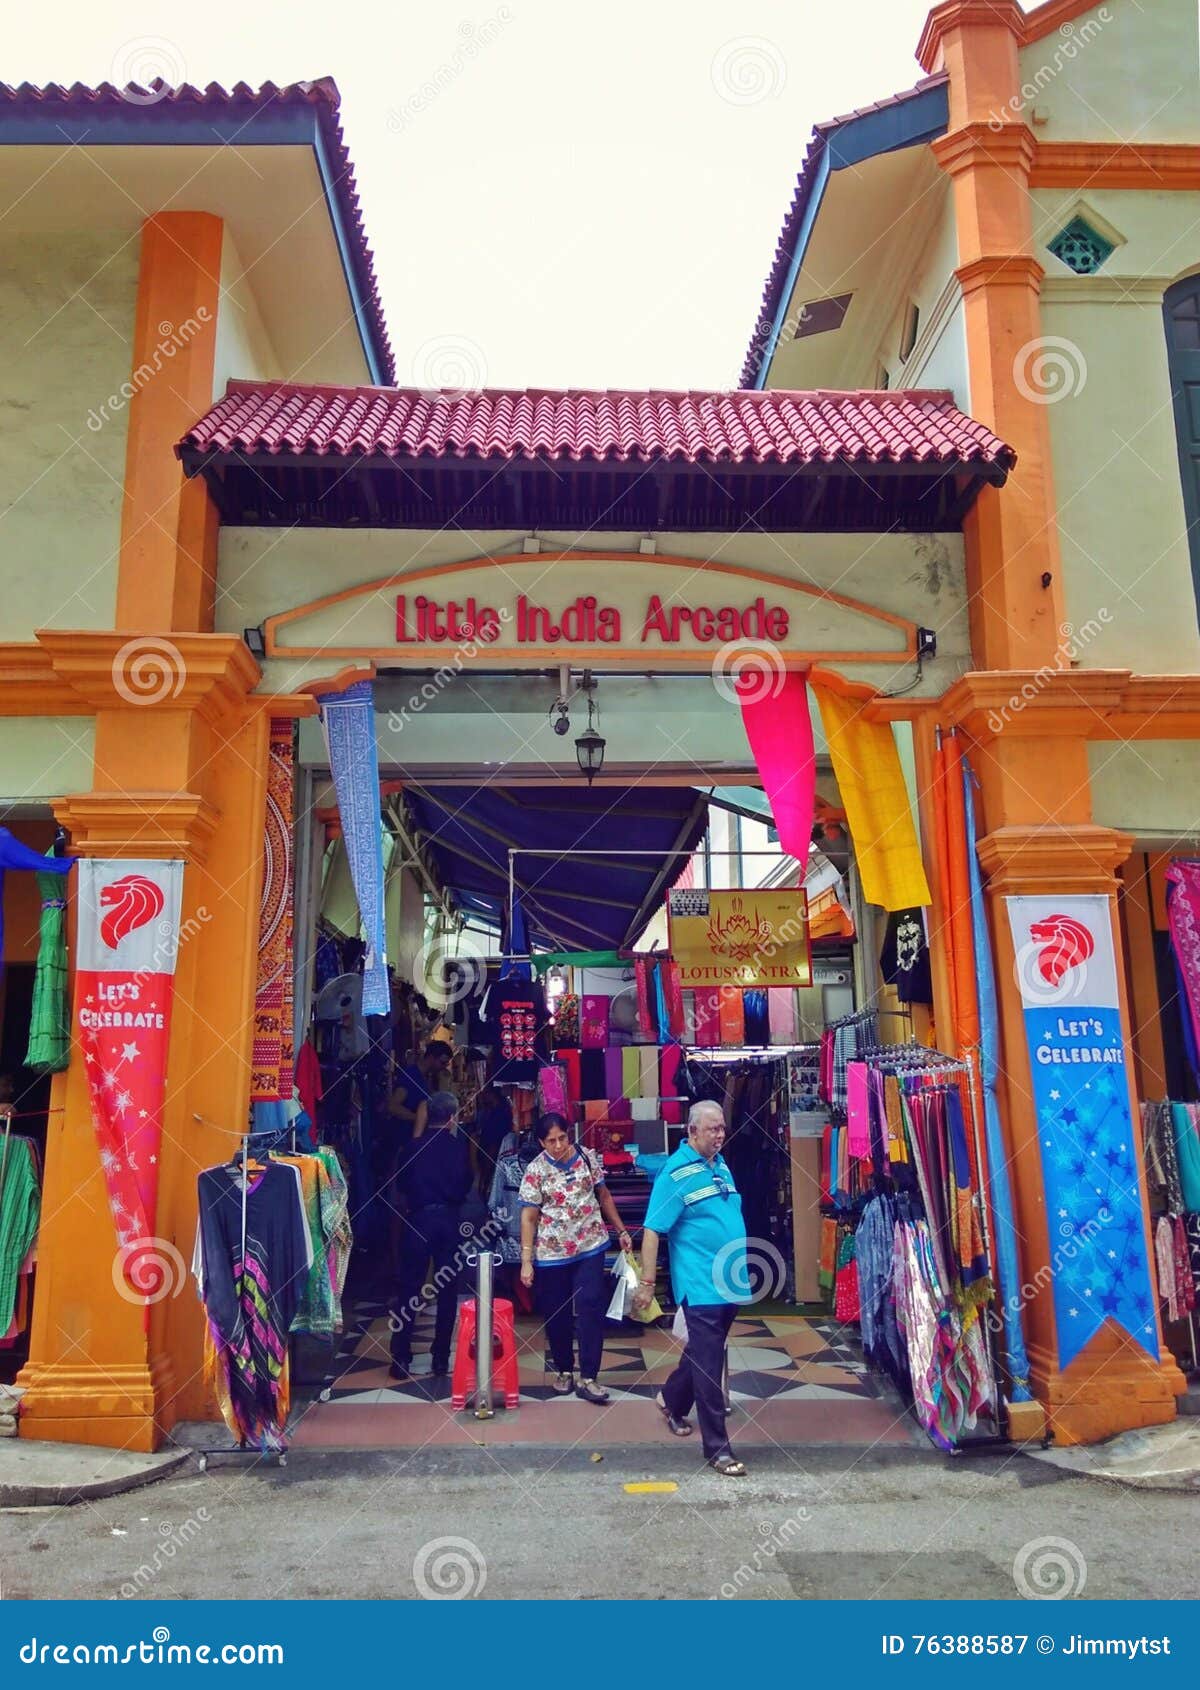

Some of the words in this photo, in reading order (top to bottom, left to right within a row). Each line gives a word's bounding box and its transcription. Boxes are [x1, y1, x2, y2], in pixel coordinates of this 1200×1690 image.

[395, 594, 500, 642] Little
[516, 594, 621, 642] India
[641, 594, 790, 642] Arcade
[681, 965, 801, 979] LOTUSMANTRA
[98, 982, 140, 1000] LET'S
[80, 1007, 164, 1029] CELEBRATE
[1058, 1018, 1104, 1037] LET'S
[1037, 1045, 1123, 1064] CELEBRATE
